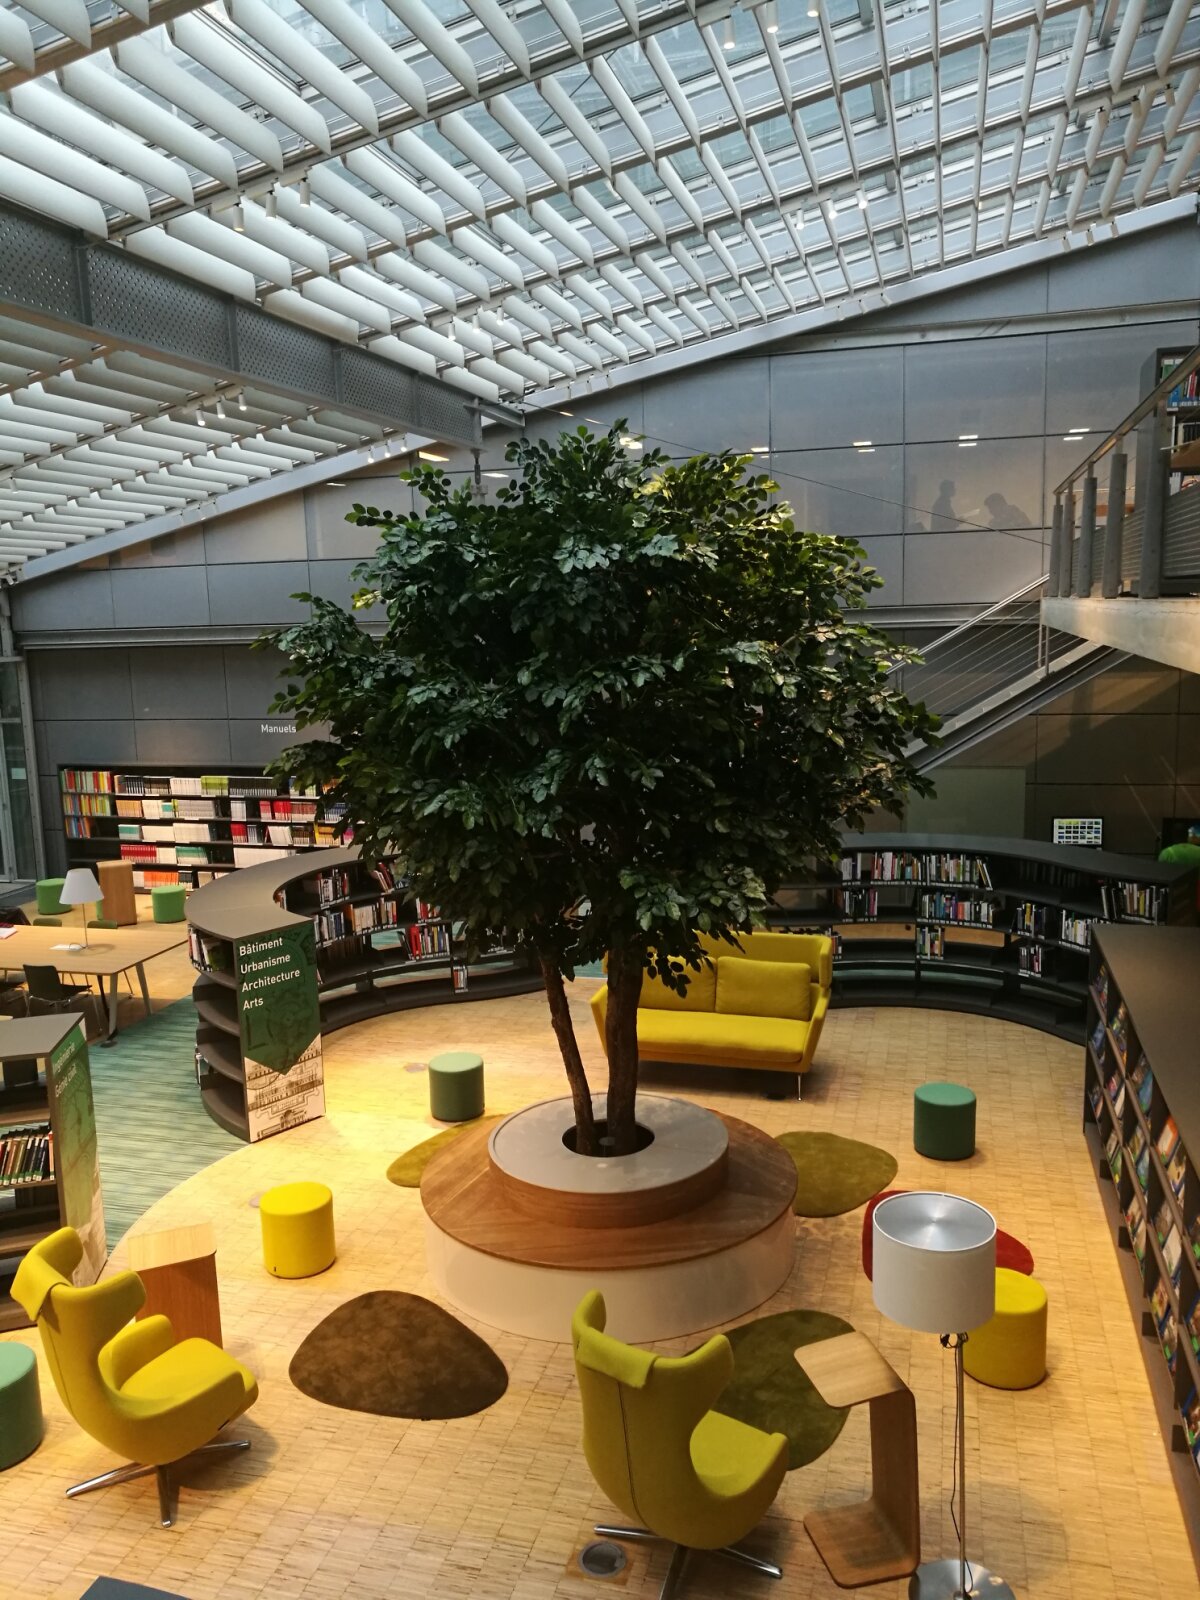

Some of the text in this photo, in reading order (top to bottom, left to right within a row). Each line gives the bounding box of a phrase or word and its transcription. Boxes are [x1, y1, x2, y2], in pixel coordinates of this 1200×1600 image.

[261, 724, 297, 733] Manuels
[239, 937, 283, 956] Bâtiment
[240, 954, 291, 974] Urbanisme
[241, 969, 300, 993] Architecture
[243, 998, 264, 1011] Arts
